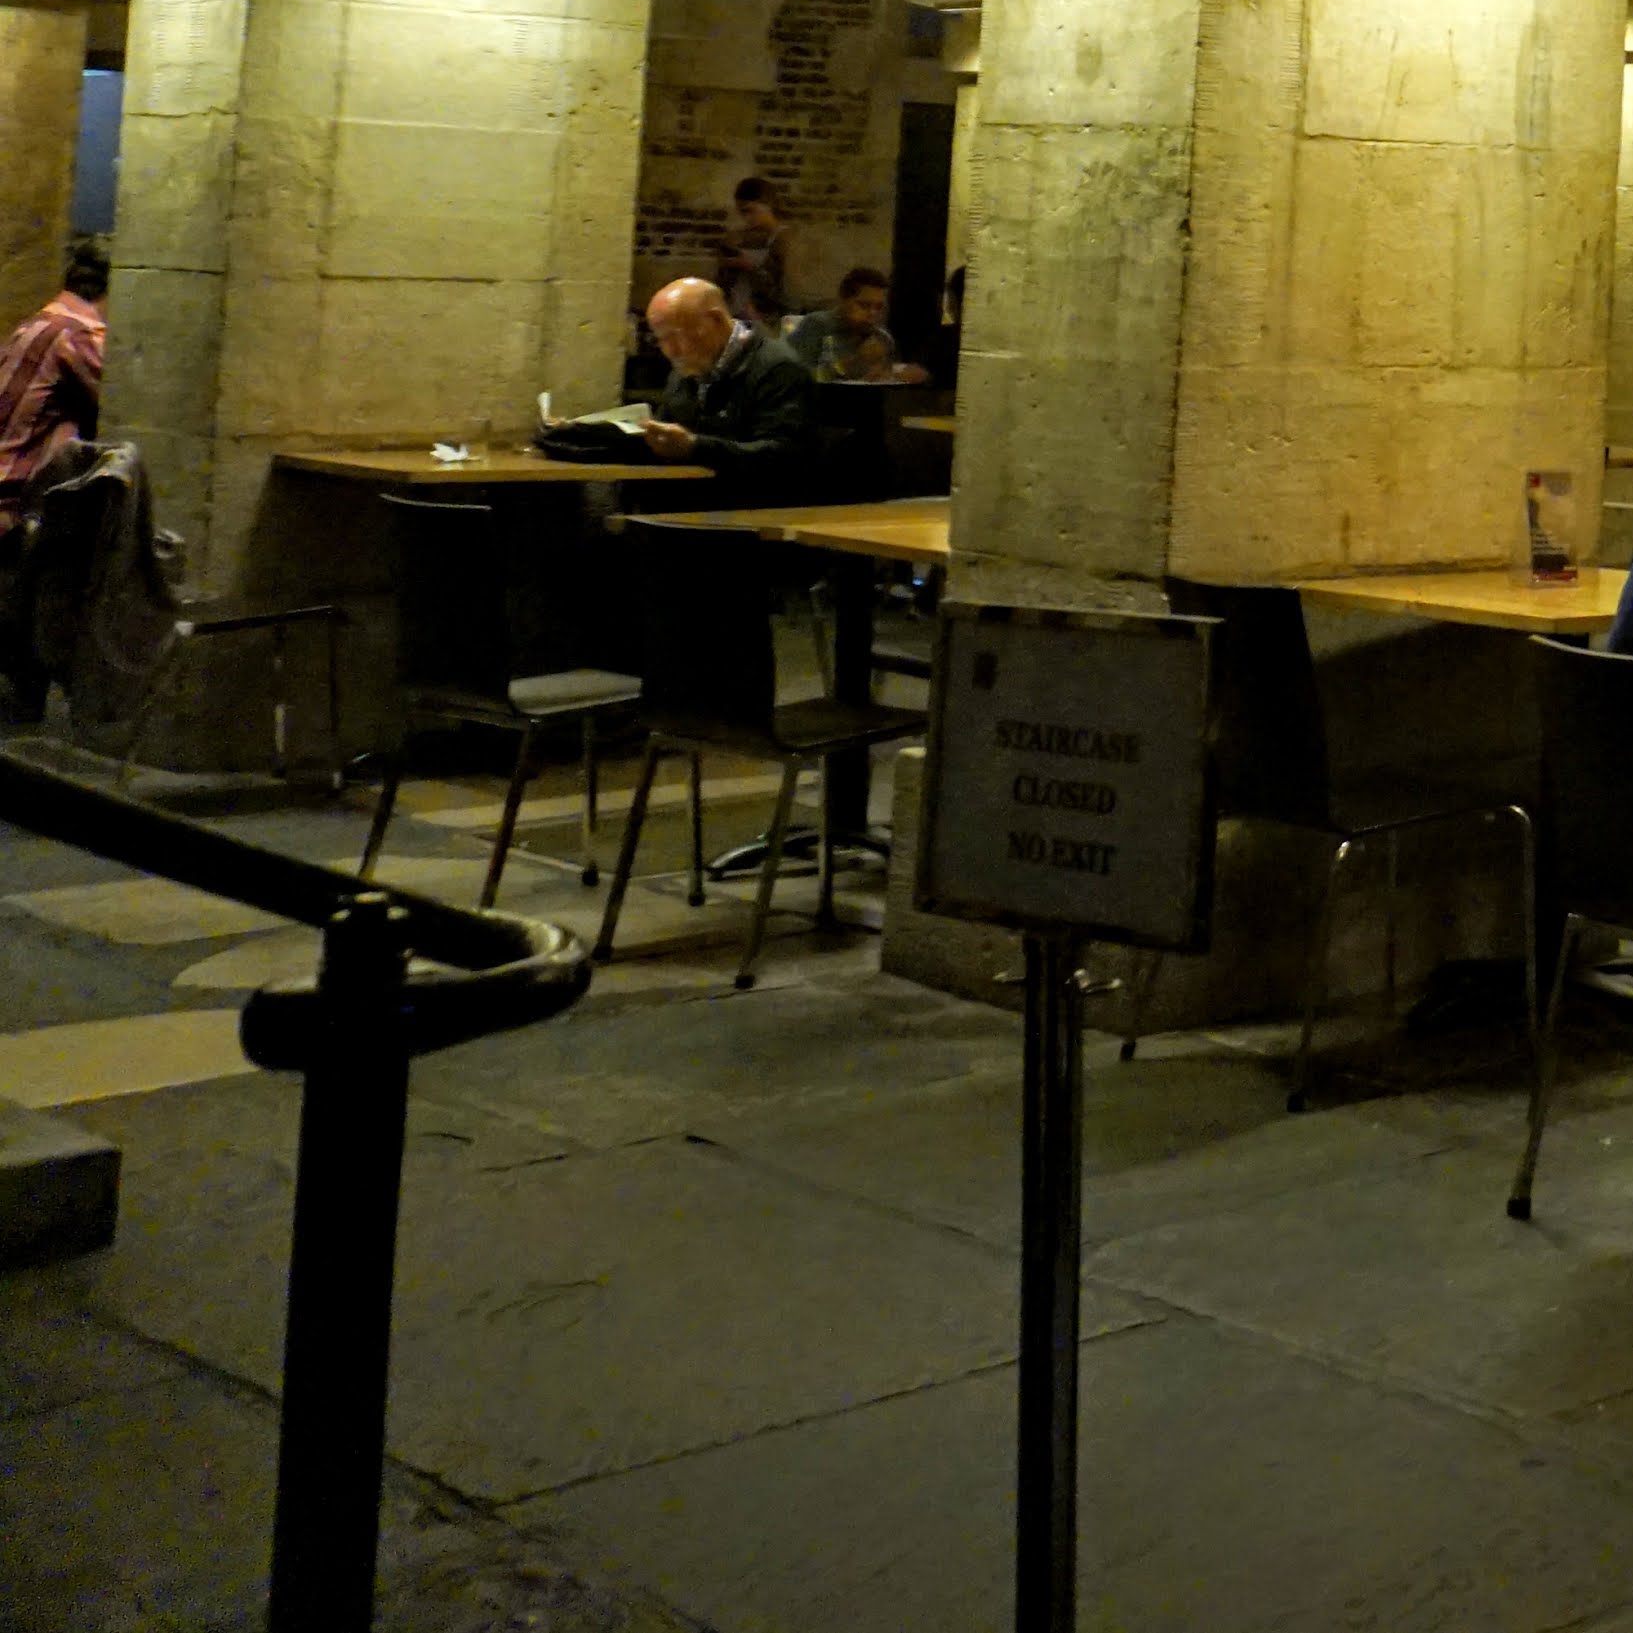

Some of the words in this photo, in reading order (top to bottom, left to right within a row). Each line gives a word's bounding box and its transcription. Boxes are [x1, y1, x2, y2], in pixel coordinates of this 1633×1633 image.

[995, 720, 1141, 764] STAIRCASE
[1013, 773, 1117, 815] CLOSED
[1007, 830, 1046, 863] NO
[1052, 837, 1118, 876] EXIT
